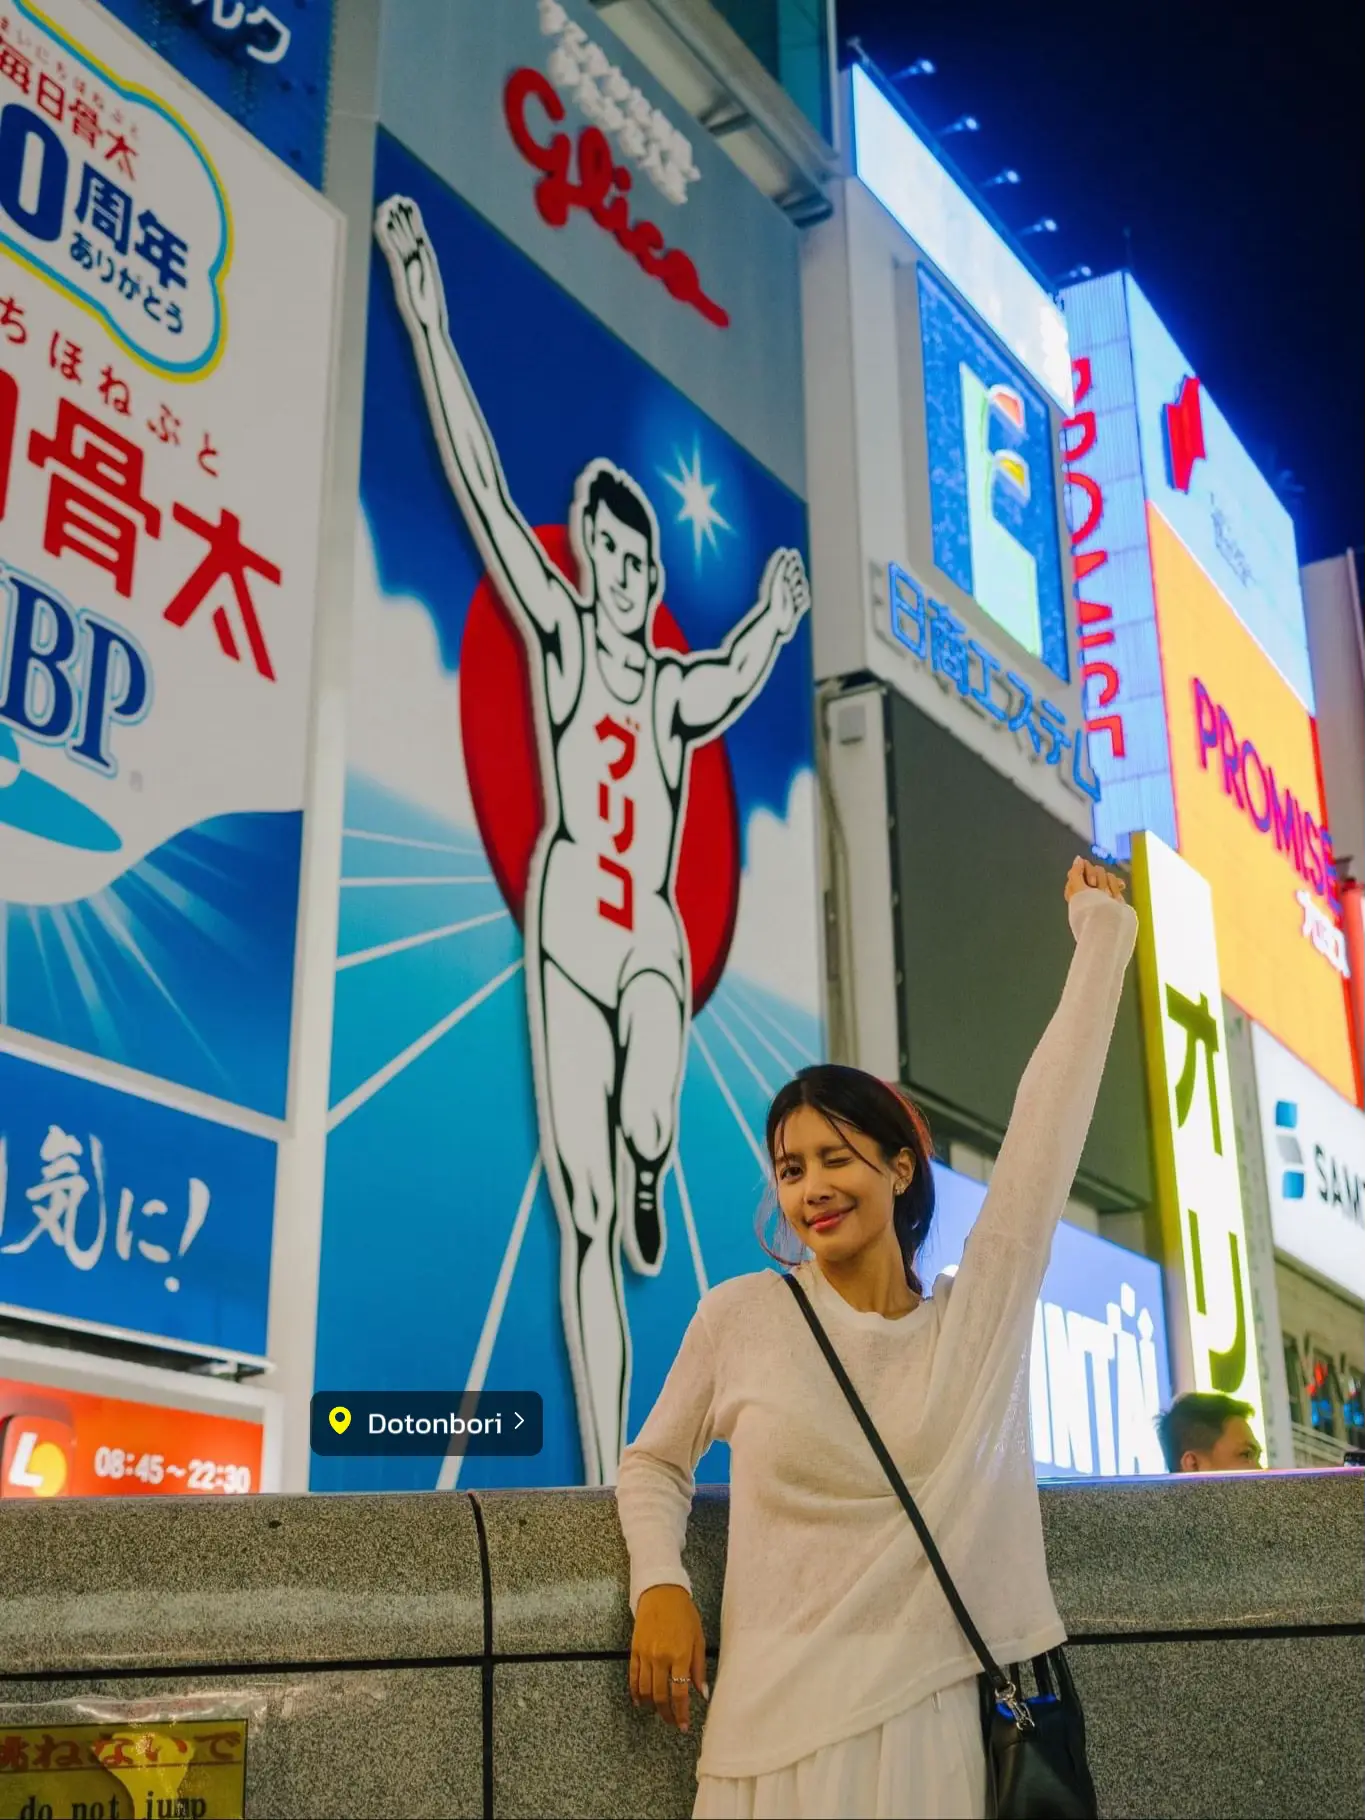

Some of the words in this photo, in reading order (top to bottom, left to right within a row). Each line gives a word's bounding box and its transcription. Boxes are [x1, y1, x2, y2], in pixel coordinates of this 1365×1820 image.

[69, 231, 185, 335] ありがとう
[503, 66, 730, 329] Glico
[594, 714, 641, 932] グリコ
[1191, 677, 1343, 918] PROMISE
[0, 1124, 210, 1293] 気に!
[1165, 982, 1247, 1394] オリ
[20, 1795, 53, 1819] do
[72, 1794, 119, 1819] not
[146, 1791, 207, 1819] jump
